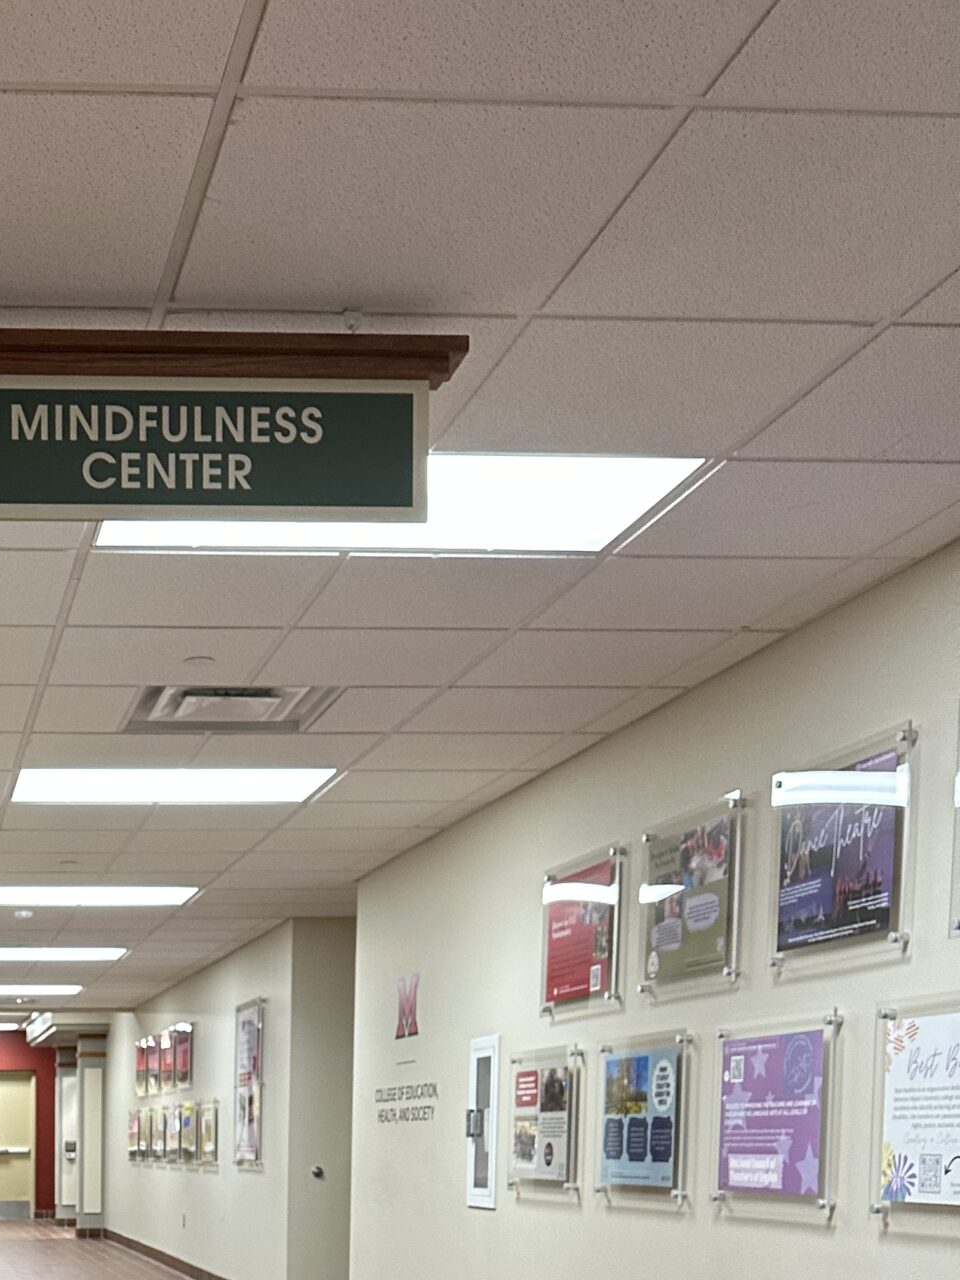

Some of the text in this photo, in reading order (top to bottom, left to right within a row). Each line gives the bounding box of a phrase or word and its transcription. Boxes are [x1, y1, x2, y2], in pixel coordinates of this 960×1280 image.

[10, 403, 324, 445] MINDFULNESS
[81, 451, 253, 491] CENTER
[907, 1045, 942, 1081] Best
